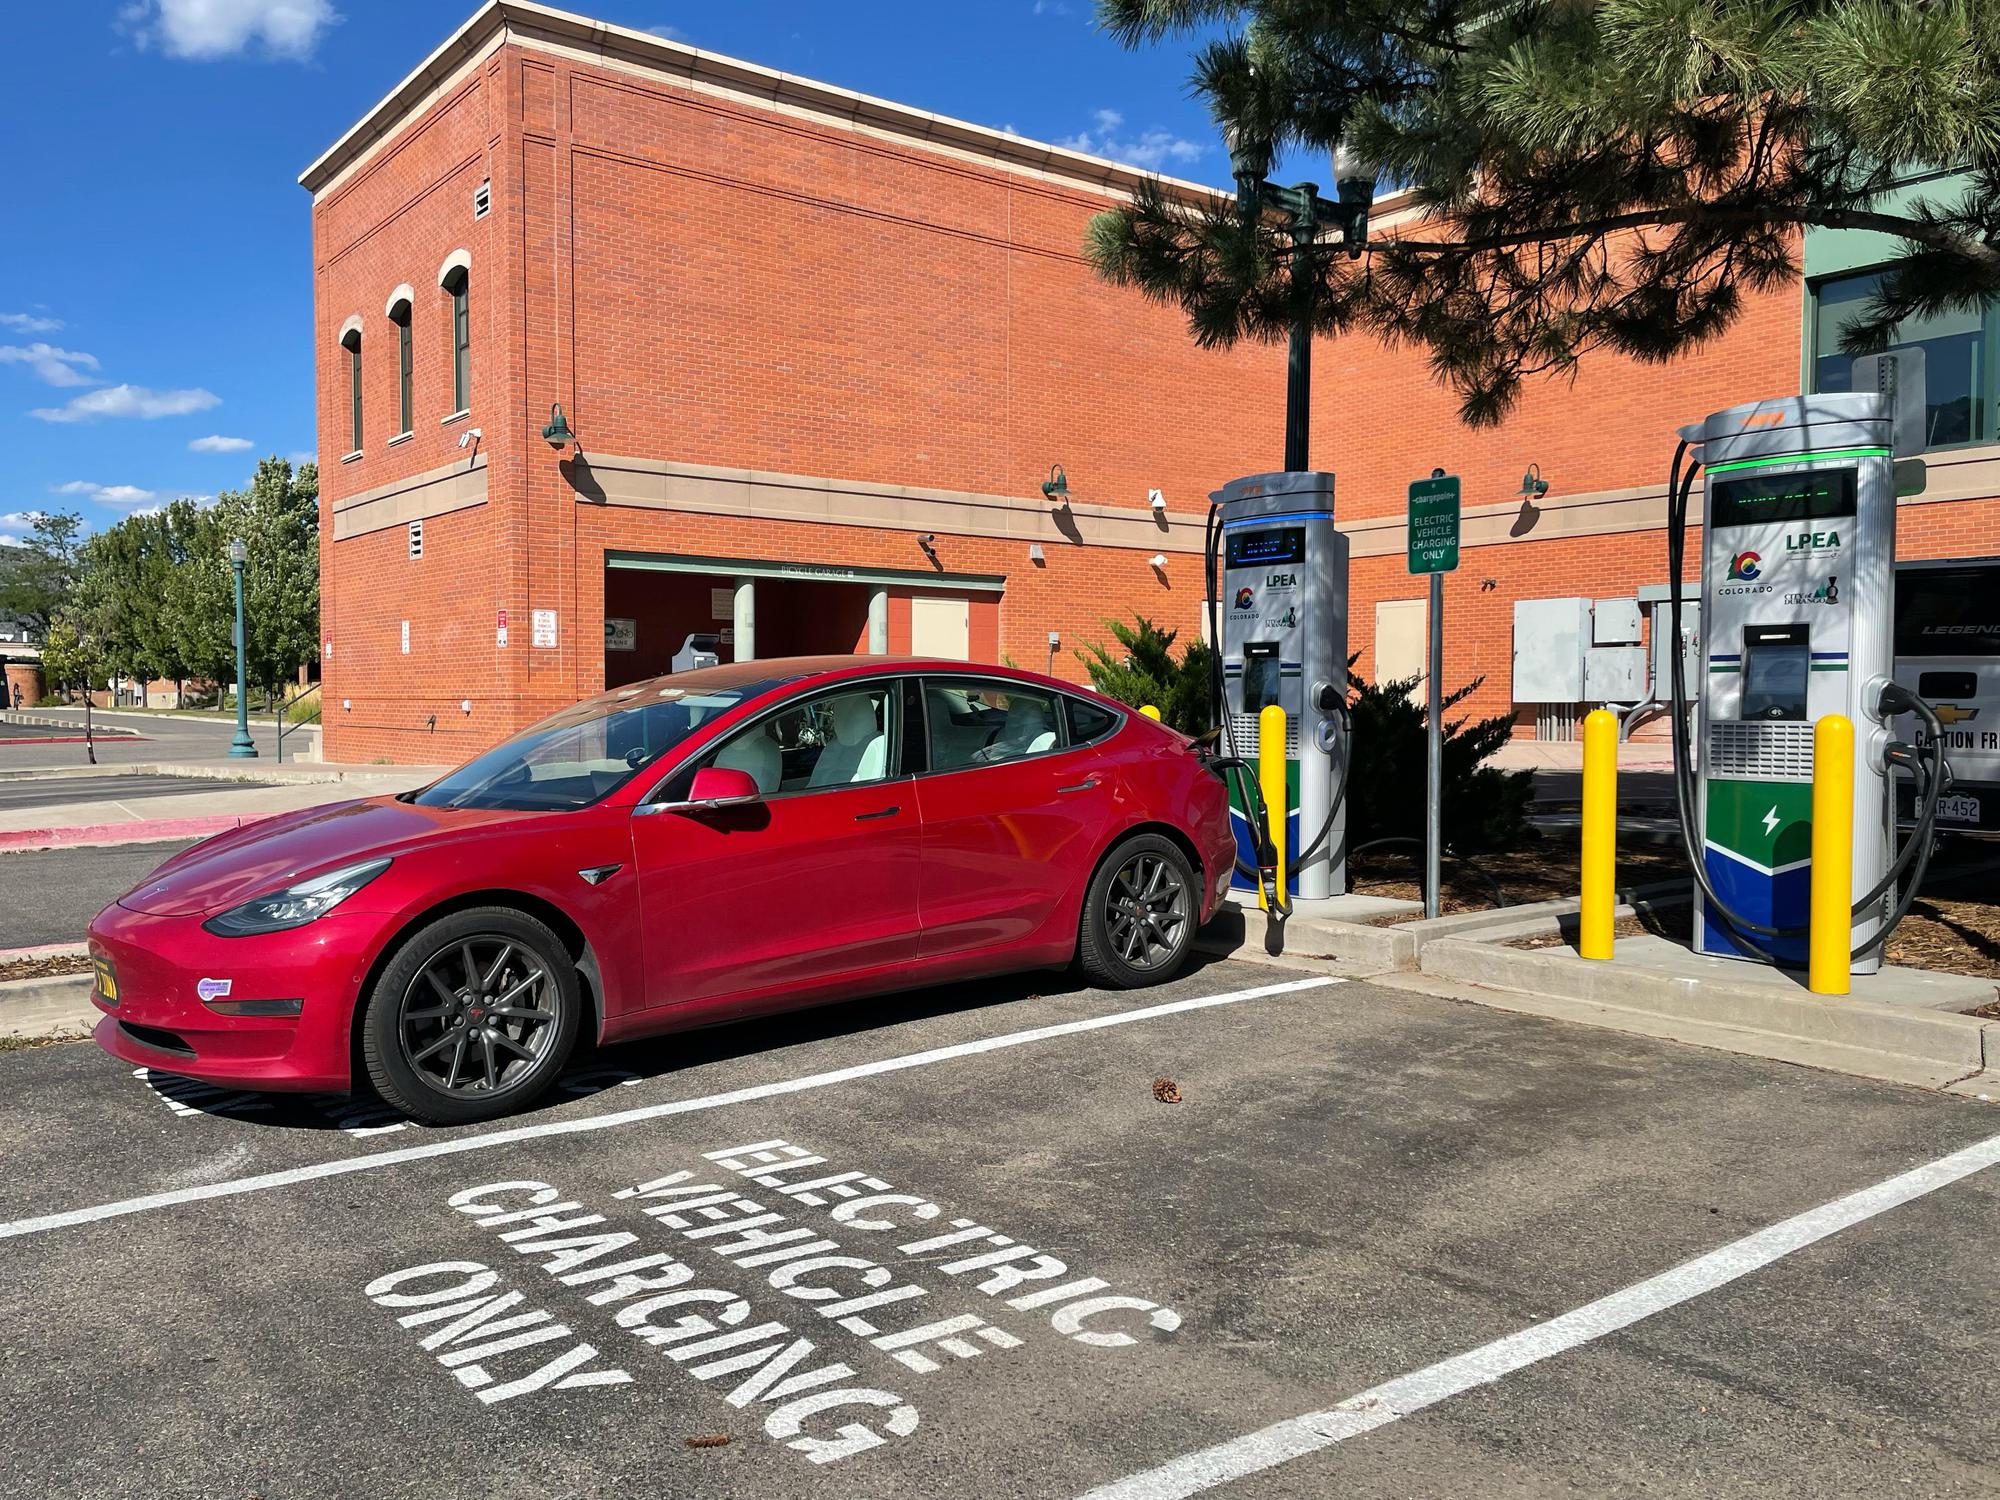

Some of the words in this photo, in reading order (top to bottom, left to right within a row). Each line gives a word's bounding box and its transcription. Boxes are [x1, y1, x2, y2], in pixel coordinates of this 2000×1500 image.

[1414, 513, 1454, 527] ELECTRIC
[1416, 525, 1452, 538] VEHICLE
[1411, 536, 1456, 550] CHARGING
[1786, 531, 1841, 550] LPEA
[1422, 549, 1445, 560] ONLY
[781, 565, 812, 575] BICYCLE
[815, 567, 846, 578] GARAGE
[1266, 574, 1297, 587] LPEA
[1718, 585, 1773, 596] COLORADO
[1784, 592, 1804, 600] CITY
[1229, 613, 1260, 621] COLORADO
[1915, 730, 1974, 749] CATION
[1981, 731, 2000, 750] FR
[701, 1139, 1183, 1348] ELECTRIC
[611, 1170, 1025, 1374] VEHICLE
[447, 1180, 920, 1465] CHARGING
[364, 1260, 635, 1404] ONLY
